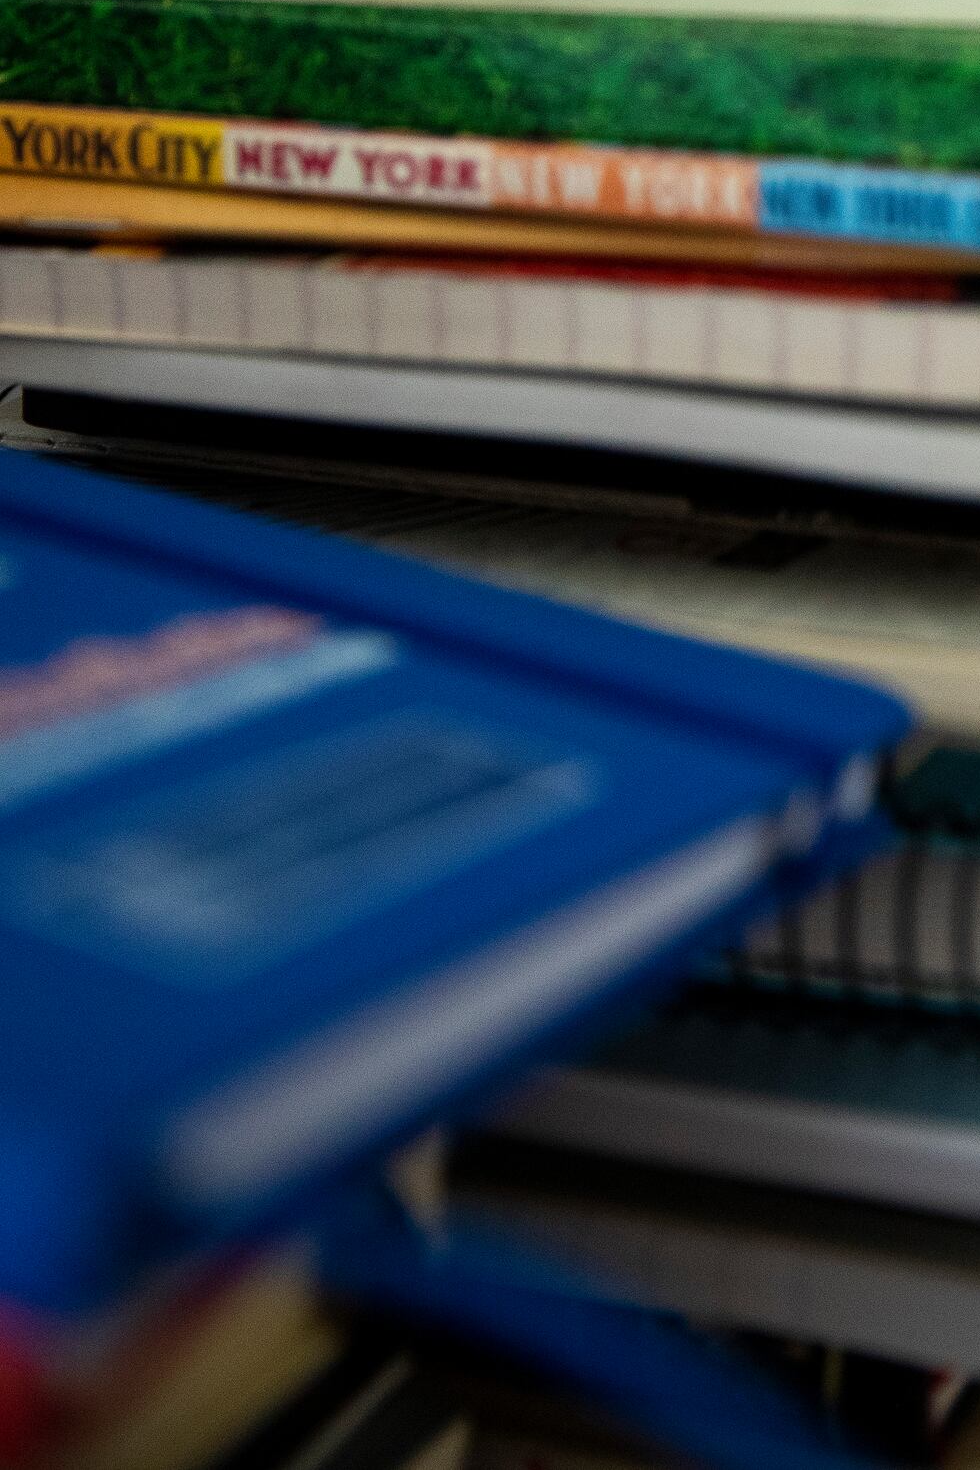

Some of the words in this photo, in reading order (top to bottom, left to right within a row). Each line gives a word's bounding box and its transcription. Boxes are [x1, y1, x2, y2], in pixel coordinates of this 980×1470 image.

[0, 114, 120, 171] YORK
[236, 137, 340, 183] NEW
[353, 146, 482, 193] YORK
